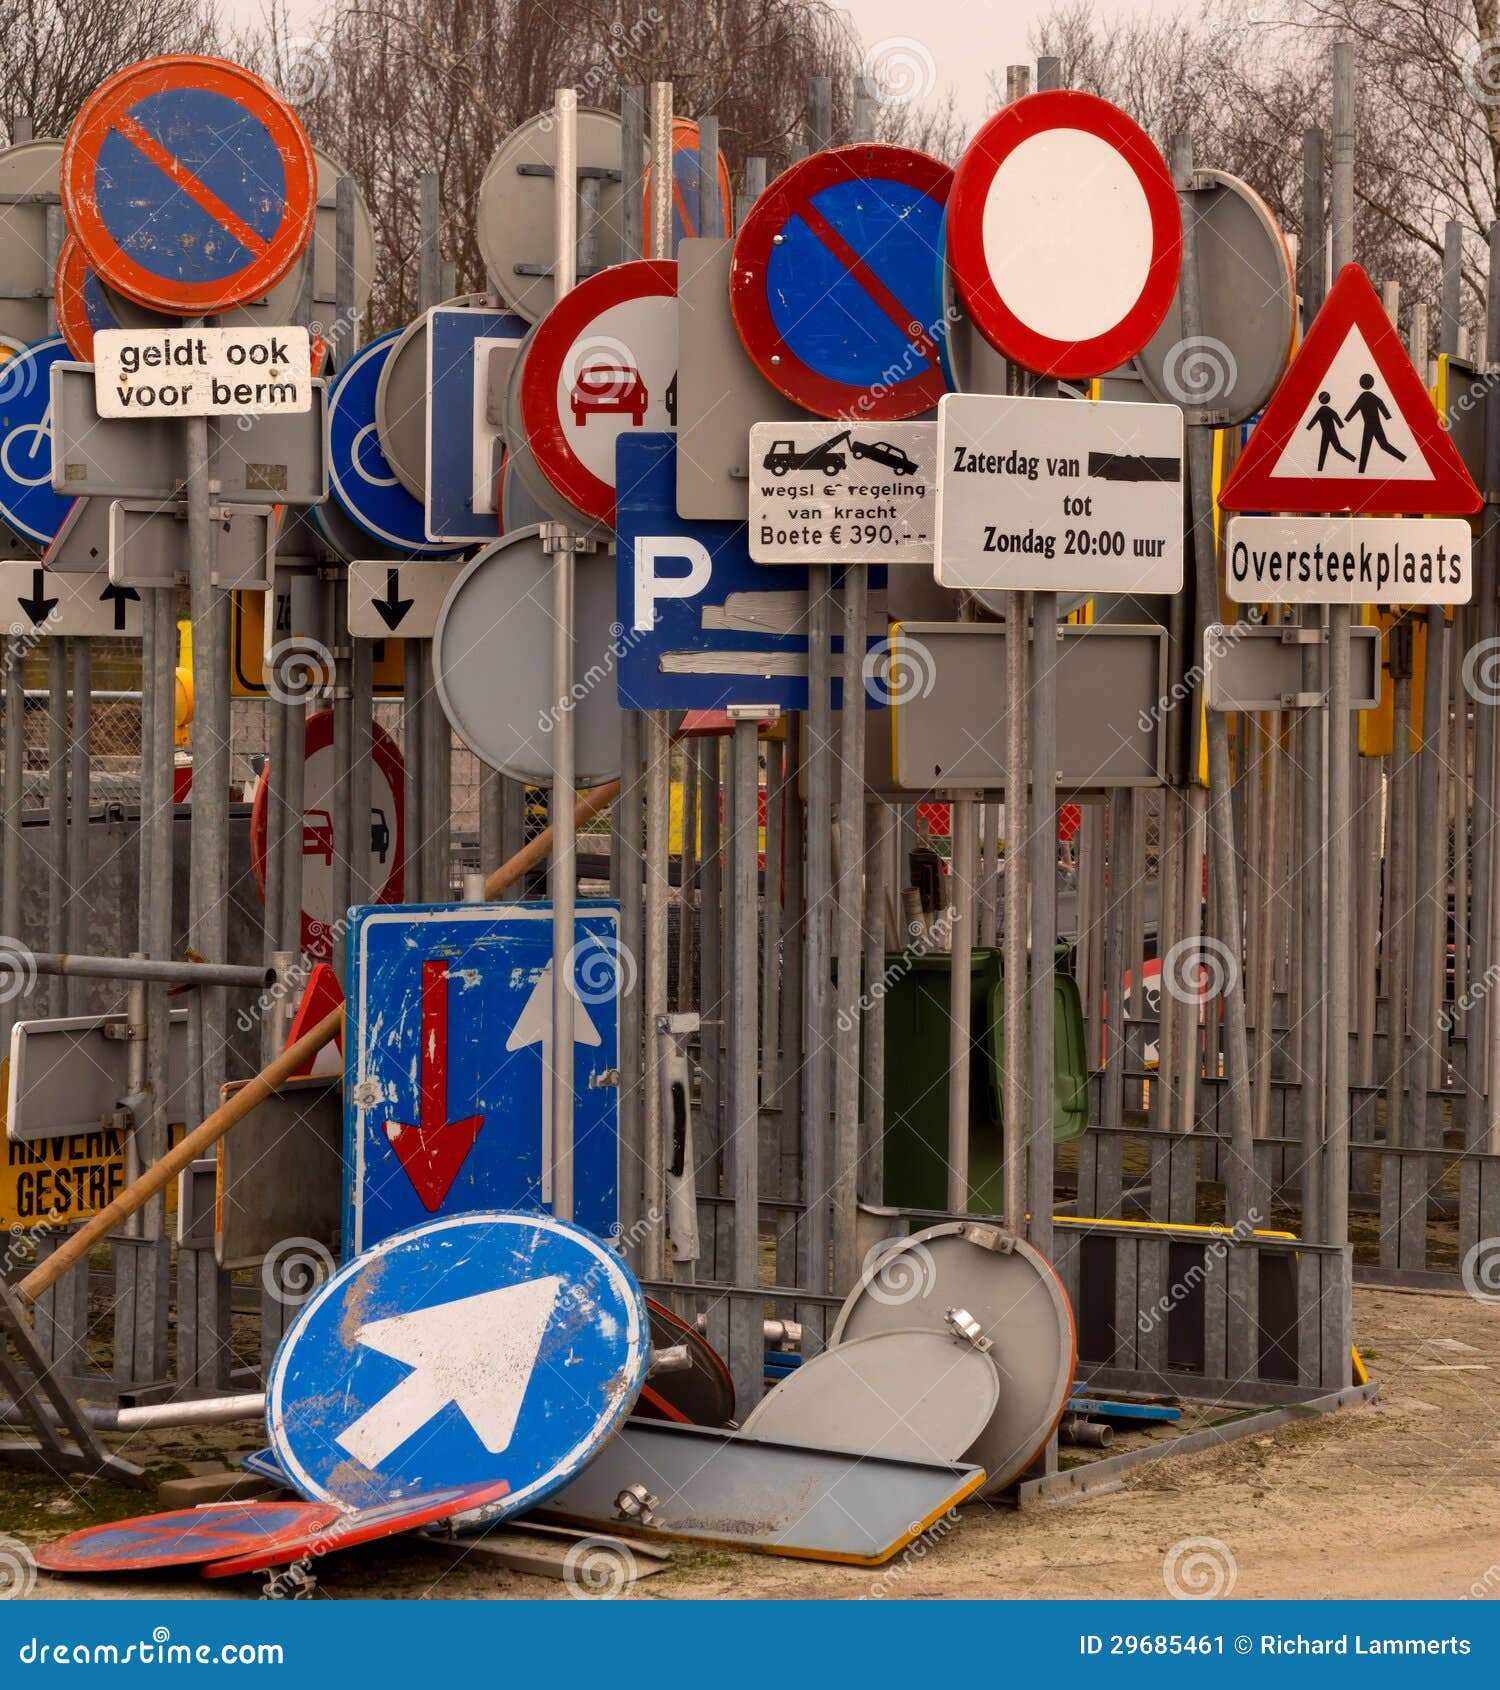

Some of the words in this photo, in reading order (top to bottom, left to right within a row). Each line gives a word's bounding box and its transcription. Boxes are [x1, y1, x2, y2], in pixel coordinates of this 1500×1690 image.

[119, 338, 207, 373] geldt
[227, 337, 290, 365] ook
[117, 384, 193, 406] voor
[212, 377, 297, 405] berm
[953, 446, 1040, 480] Zaterdag
[1046, 456, 1080, 477] van
[788, 508, 822, 520] van
[834, 506, 897, 520] kracht
[1063, 495, 1092, 517] tot
[761, 526, 822, 545] Boete
[983, 526, 1057, 559] Zondag
[1064, 529, 1125, 556] 20:00
[1133, 537, 1166, 558] uur
[1232, 541, 1461, 592] Oversteekplaats
[634, 536, 712, 631] P
[17, 1163, 122, 1217] GESTRE
